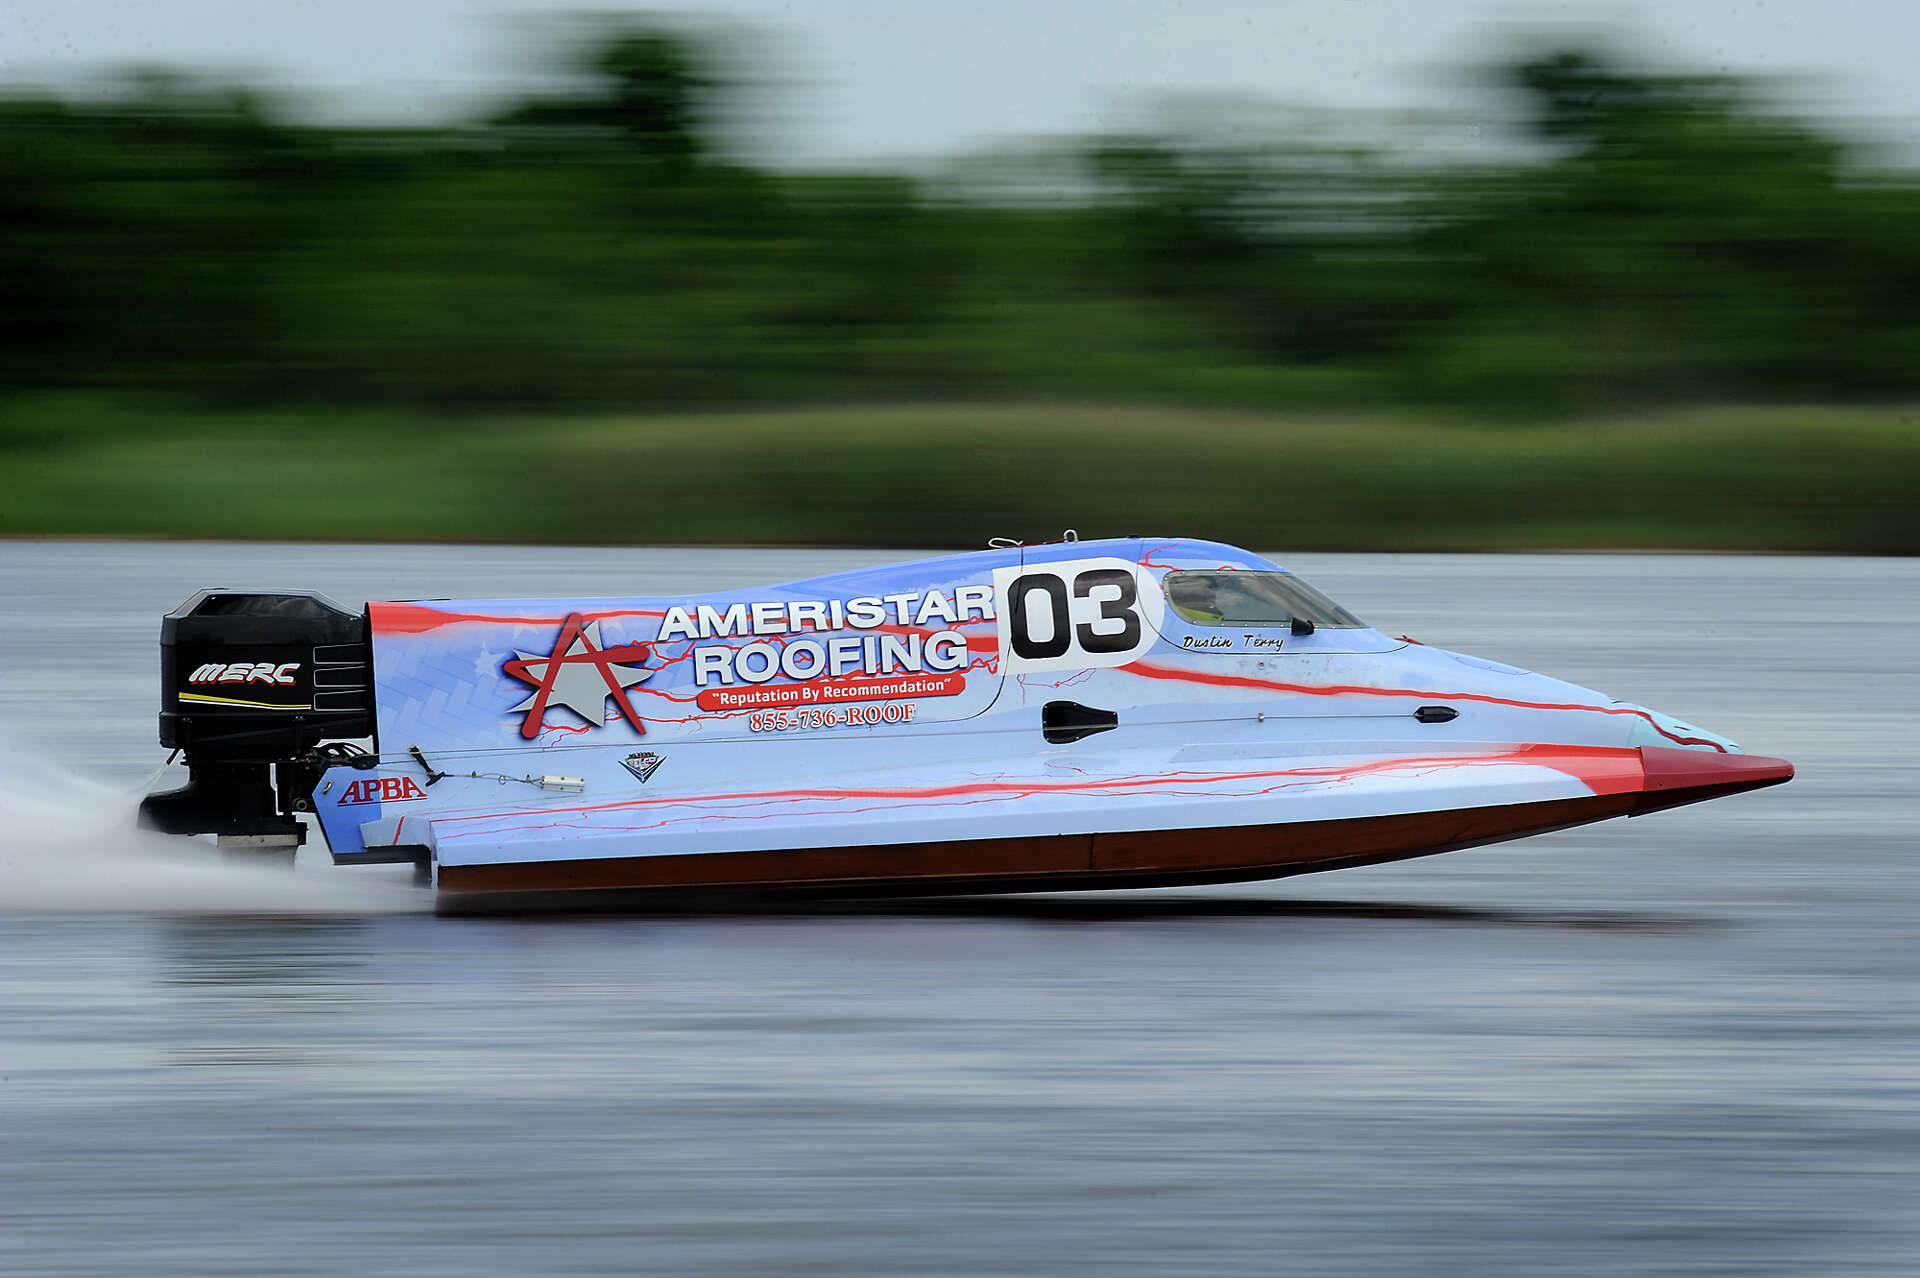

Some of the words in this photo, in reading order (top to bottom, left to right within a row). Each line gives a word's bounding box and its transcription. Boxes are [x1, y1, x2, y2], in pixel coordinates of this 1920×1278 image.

[657, 585, 995, 642] AMERISTAR
[1007, 569, 1141, 660] 03
[1183, 635, 1233, 648] Dustin
[1244, 634, 1284, 652] Terry
[693, 631, 968, 686] ROOFING
[189, 662, 301, 685] MERC
[712, 690, 799, 706] "Reputation
[802, 687, 820, 702] By
[823, 678, 952, 699] Recommendation"
[750, 703, 917, 732] 855-736-ROOF
[337, 776, 428, 804] APBA
